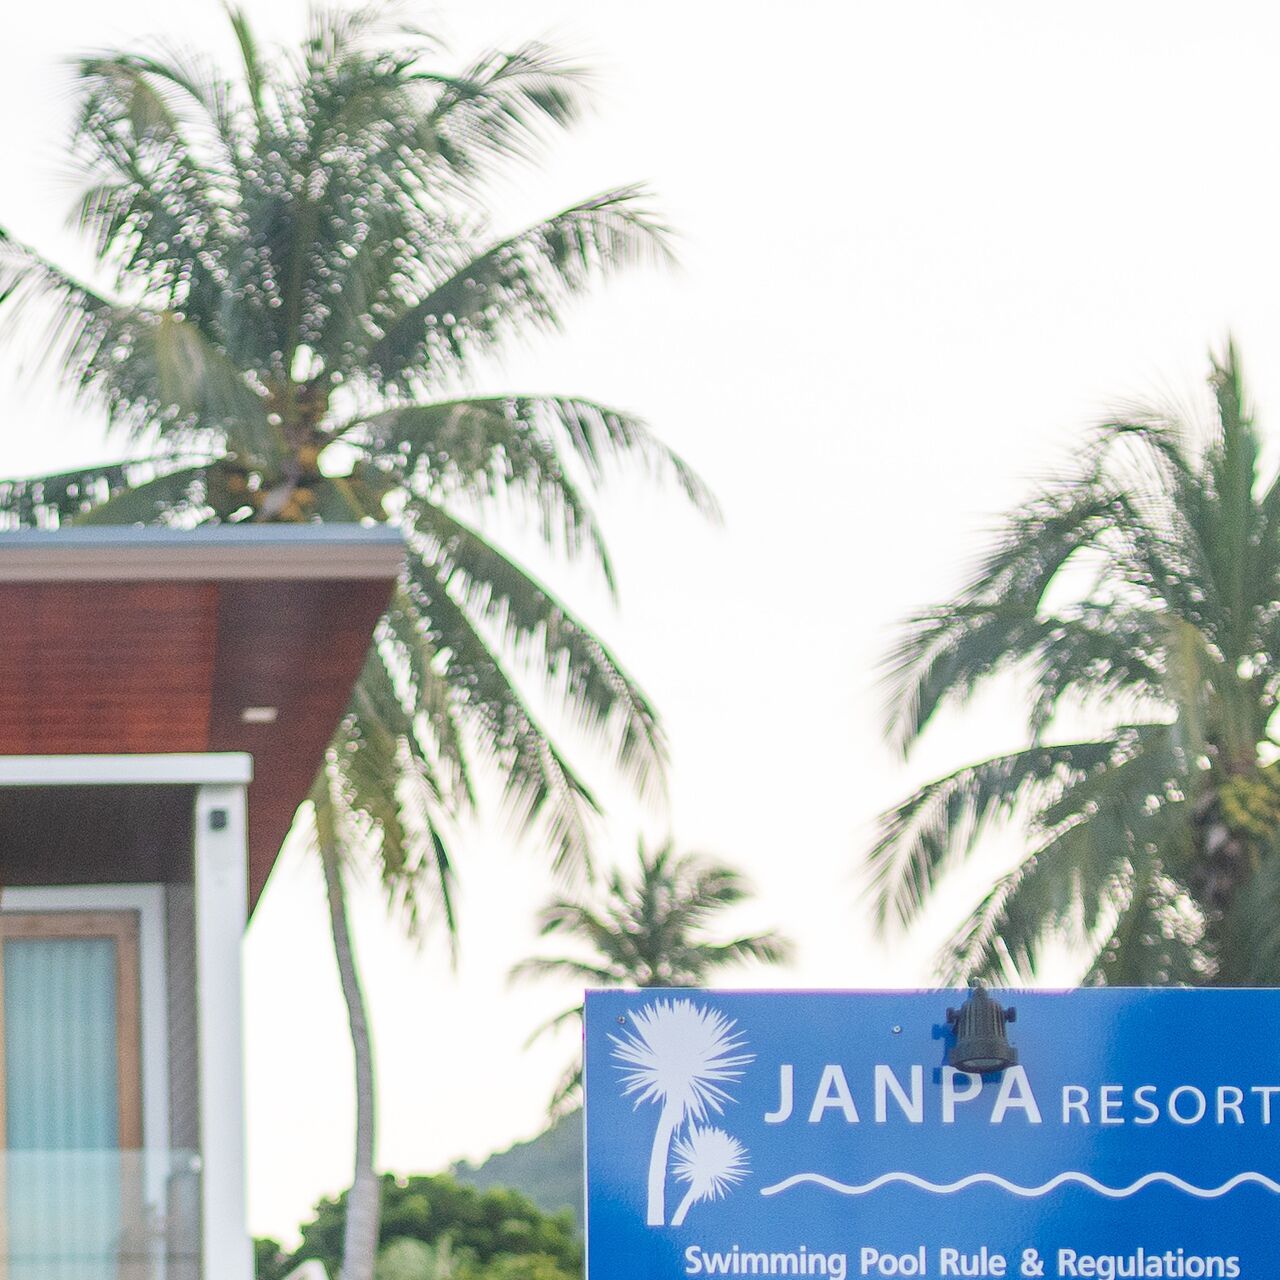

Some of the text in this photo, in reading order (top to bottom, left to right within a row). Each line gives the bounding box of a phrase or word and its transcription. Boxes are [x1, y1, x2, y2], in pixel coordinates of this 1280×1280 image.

[763, 1063, 1280, 1125] JANPA RESORT
[859, 1245, 927, 1278] Pool
[939, 1245, 1007, 1278] Rule
[1020, 1247, 1045, 1277] &
